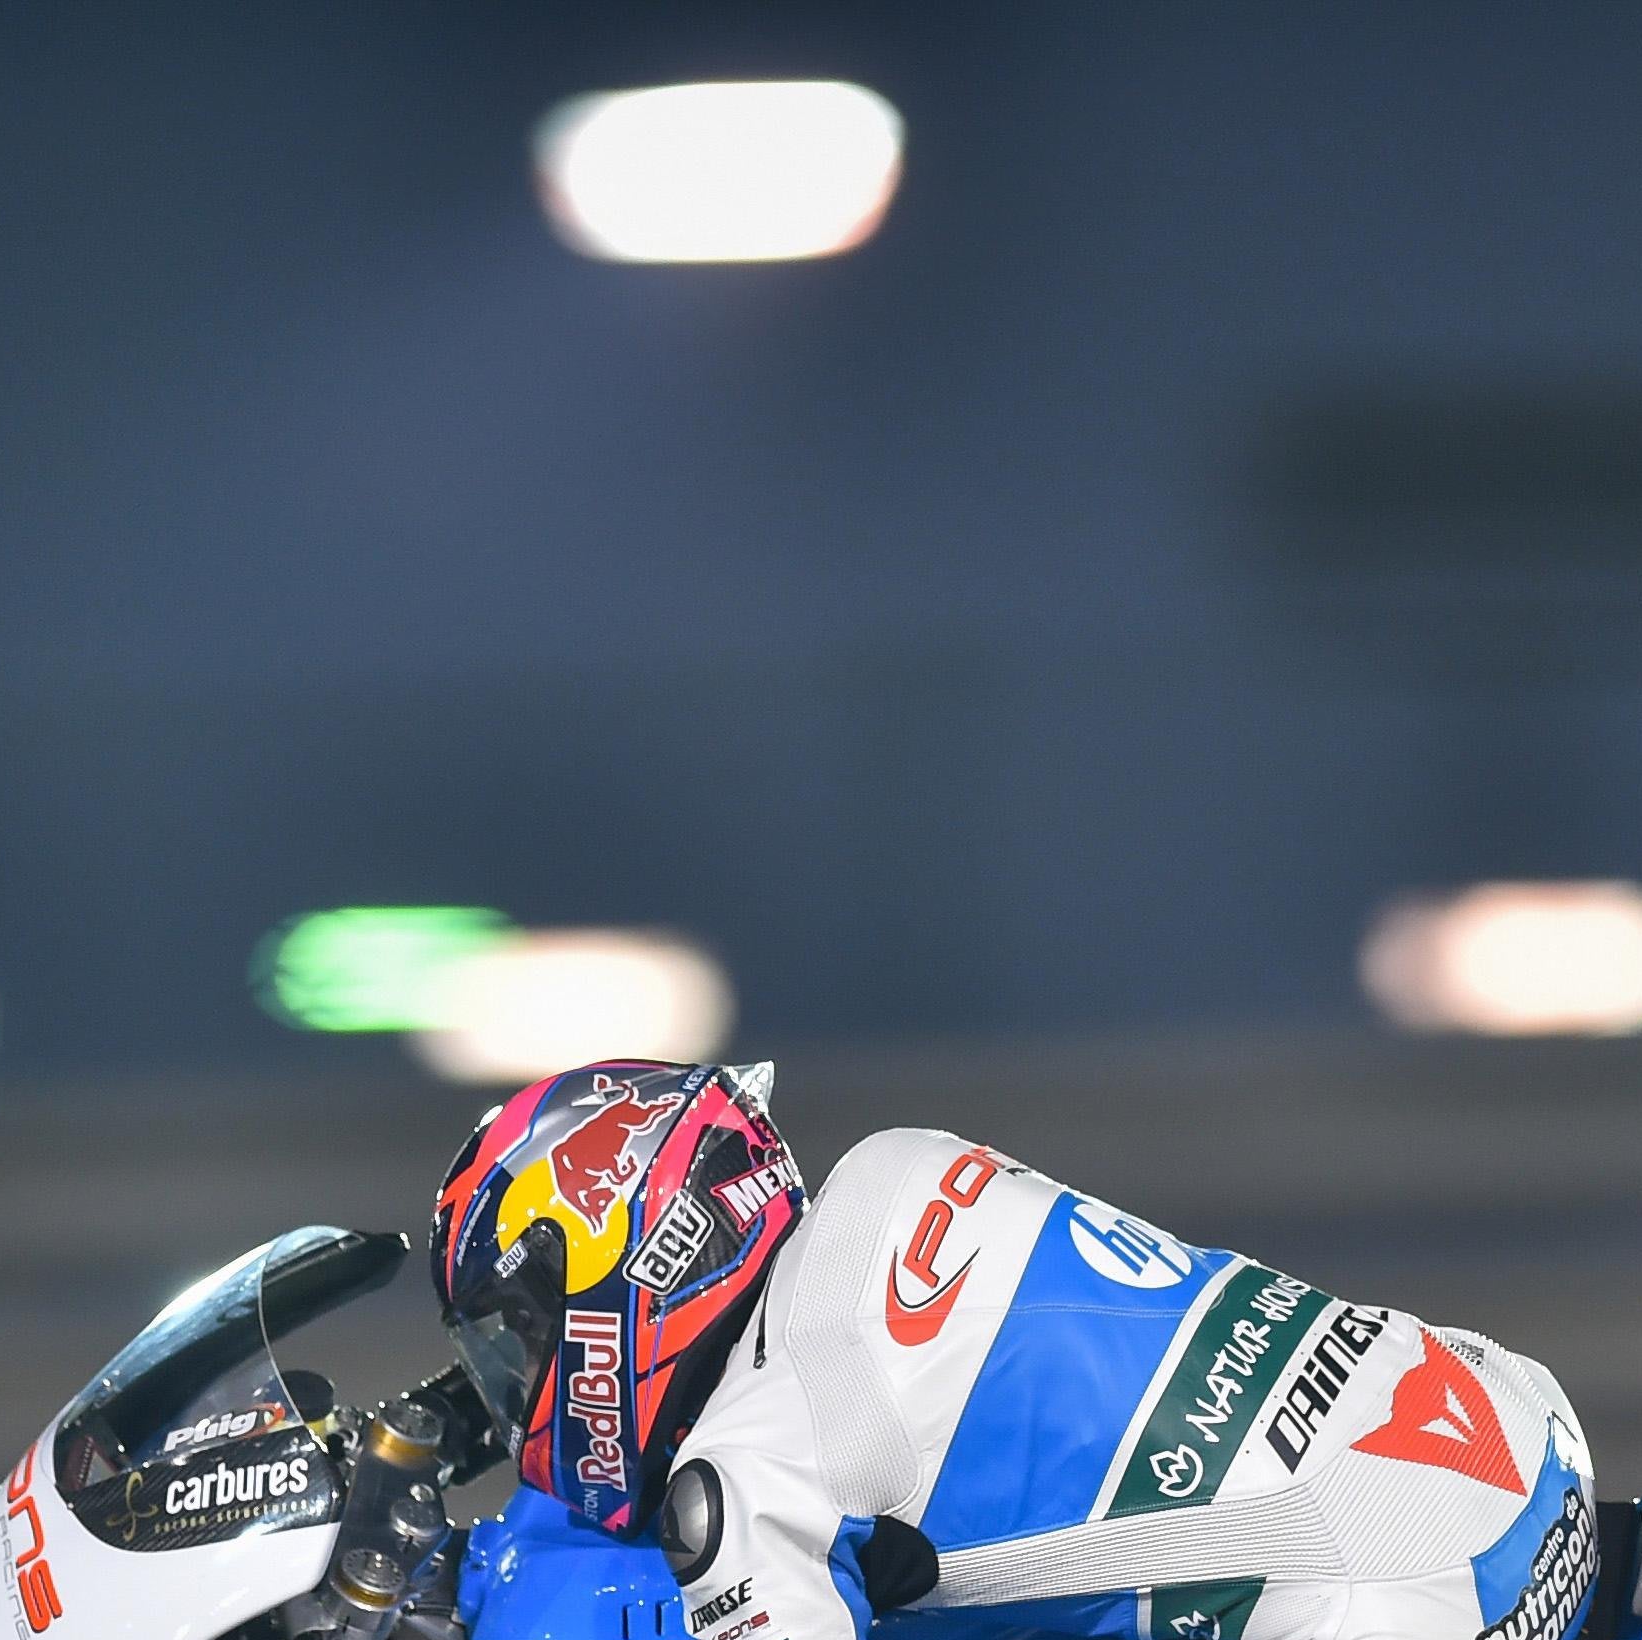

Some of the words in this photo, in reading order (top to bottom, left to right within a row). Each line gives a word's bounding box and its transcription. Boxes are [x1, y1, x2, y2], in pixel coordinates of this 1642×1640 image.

[641, 1205, 702, 1284] agv
[903, 1146, 1005, 1290] PO
[500, 1246, 525, 1275] agv
[565, 1309, 622, 1408] Bull
[1185, 1320, 1272, 1443] NATUR
[1250, 1276, 1311, 1322] HOUS
[164, 1410, 258, 1452] Puig
[568, 1402, 628, 1493] Red
[165, 1457, 309, 1515] carbures
[1533, 1526, 1565, 1582] centro
